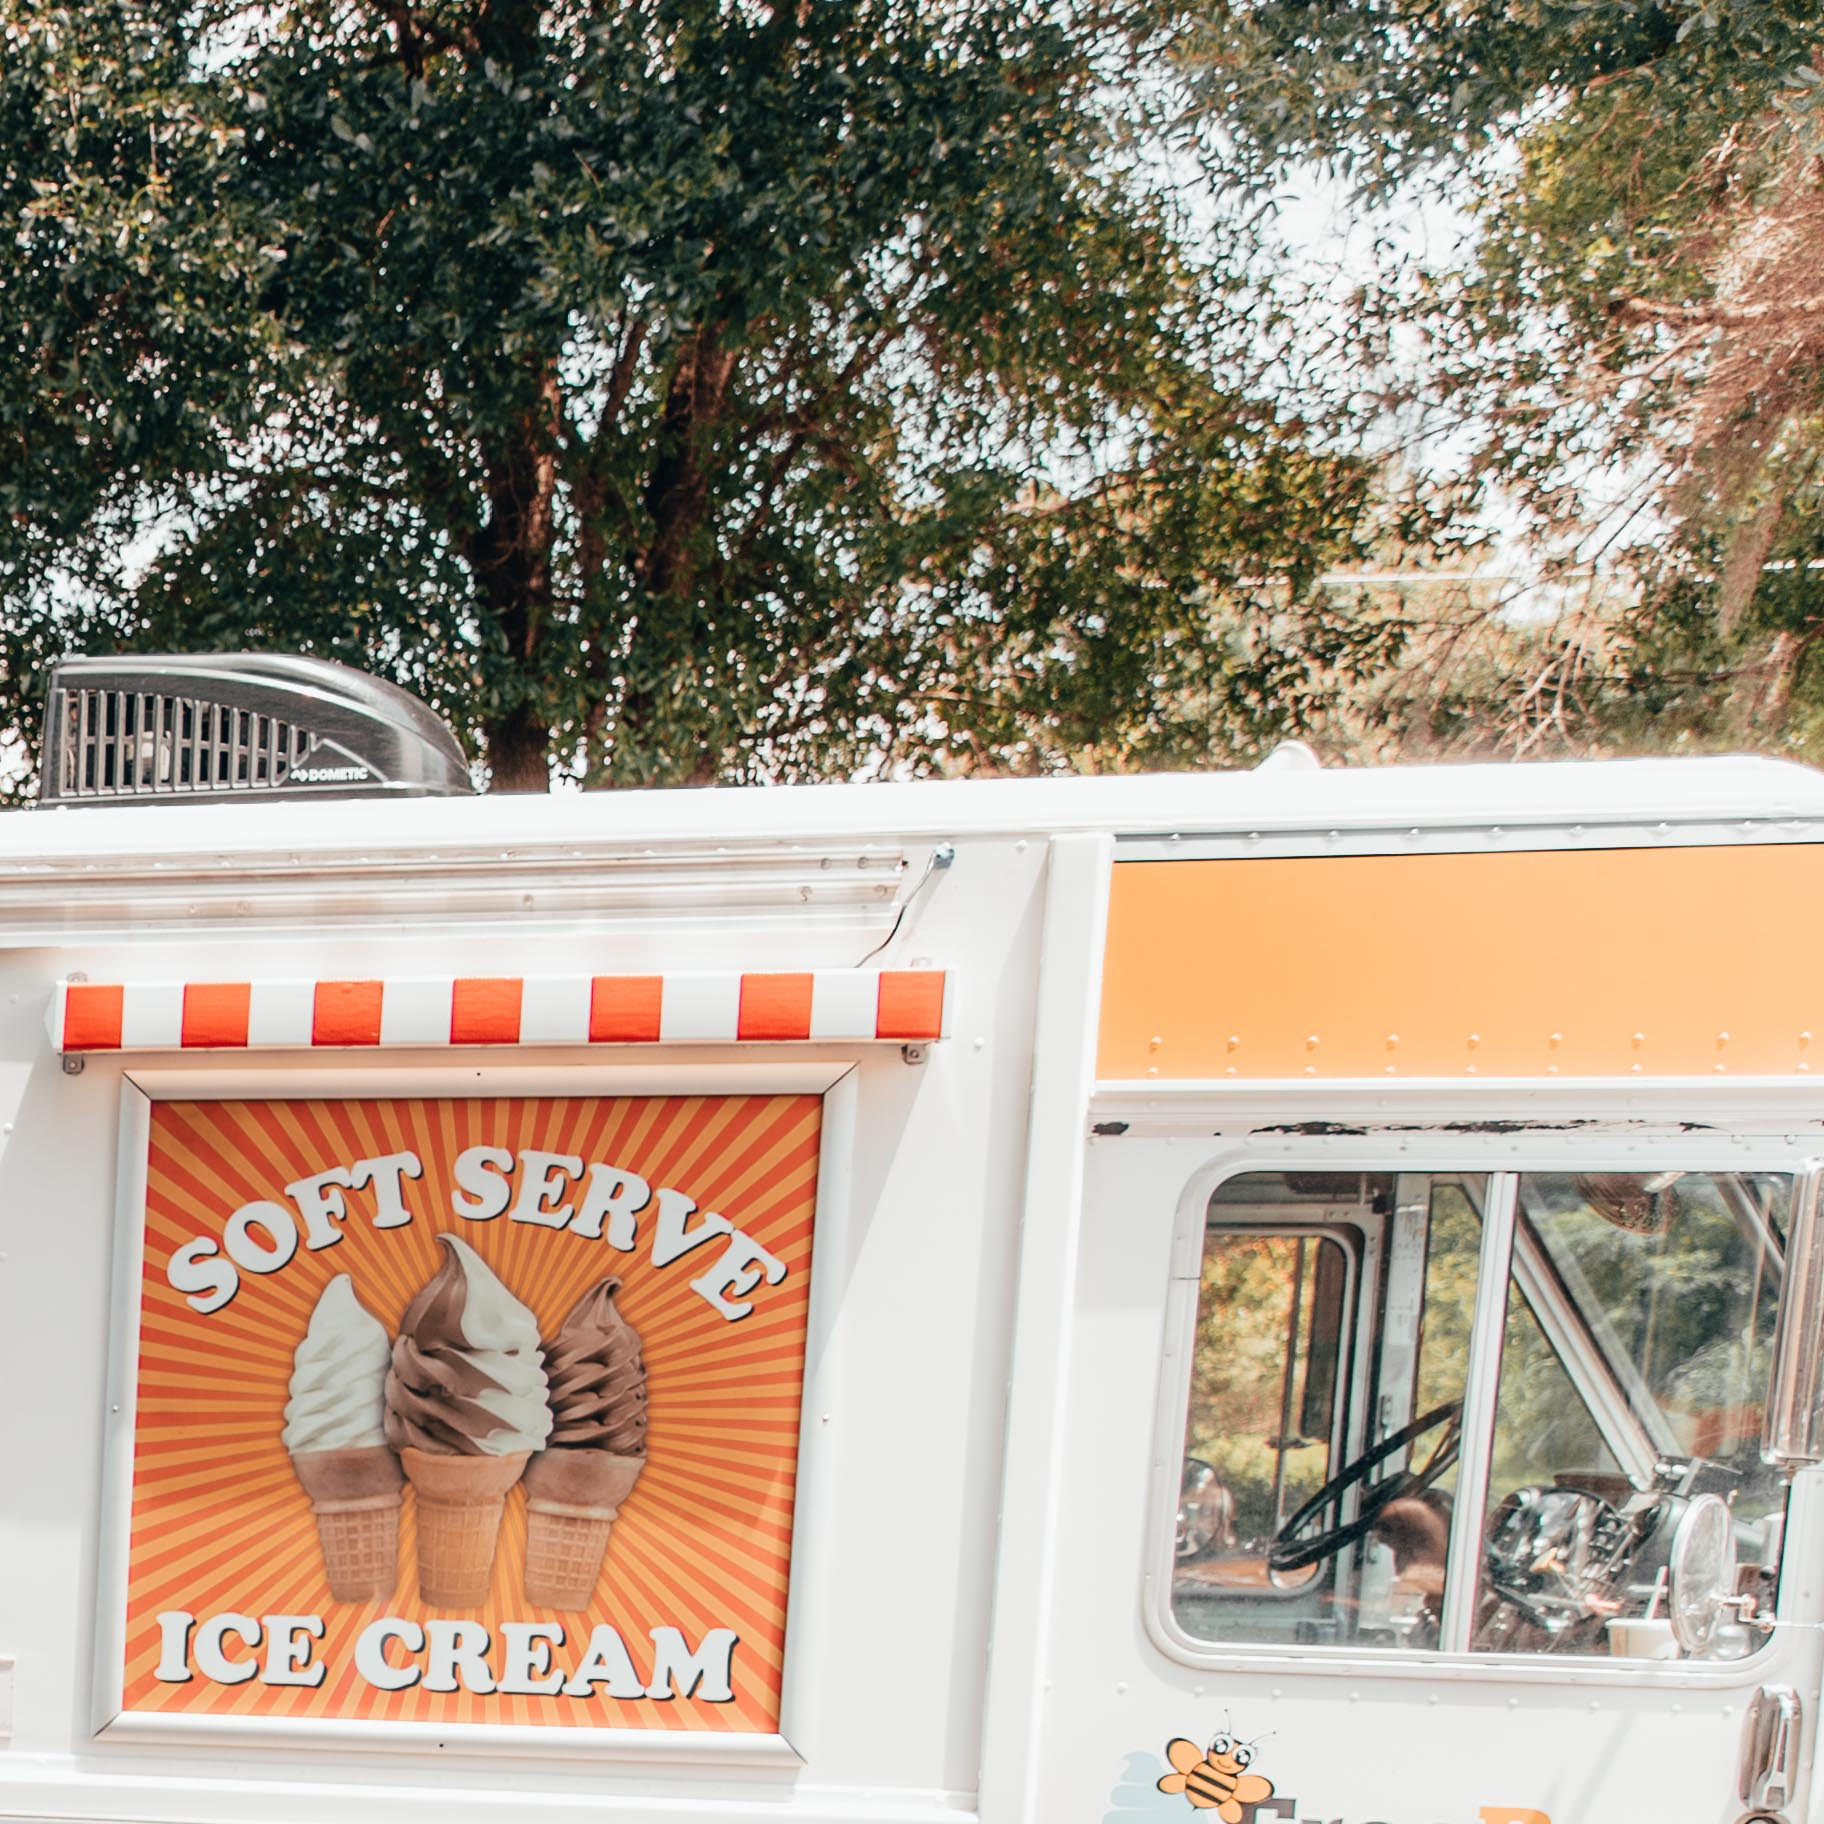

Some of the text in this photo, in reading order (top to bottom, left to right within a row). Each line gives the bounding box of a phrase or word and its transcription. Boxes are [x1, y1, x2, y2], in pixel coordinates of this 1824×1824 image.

[309, 767, 368, 781] DOMETIC
[166, 1144, 787, 1321] SOFT SERVE
[154, 1610, 739, 1703] ICE CREAM
